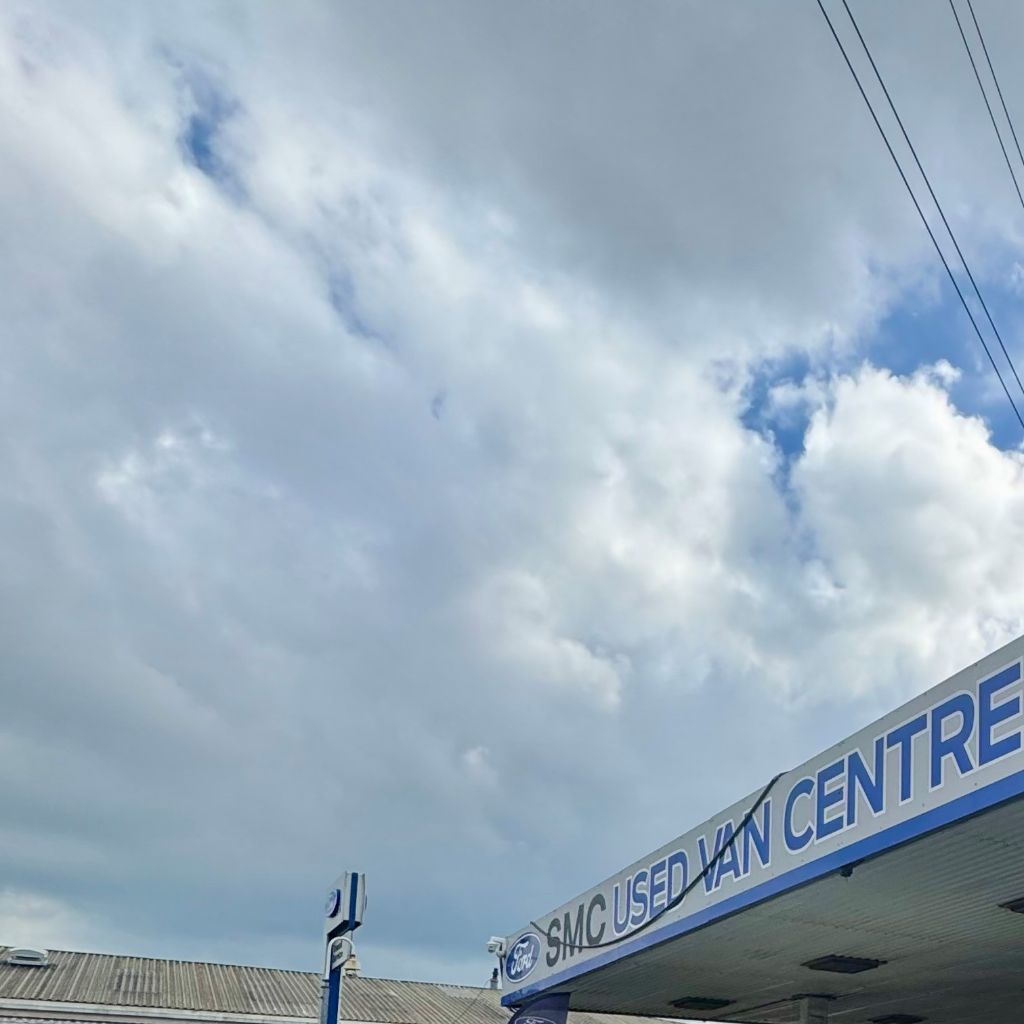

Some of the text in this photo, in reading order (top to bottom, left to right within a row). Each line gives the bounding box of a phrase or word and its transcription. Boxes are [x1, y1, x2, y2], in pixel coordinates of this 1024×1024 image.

[546, 657, 1024, 968] SMC USED VAN CENTRE
[509, 939, 536, 977] Ford
